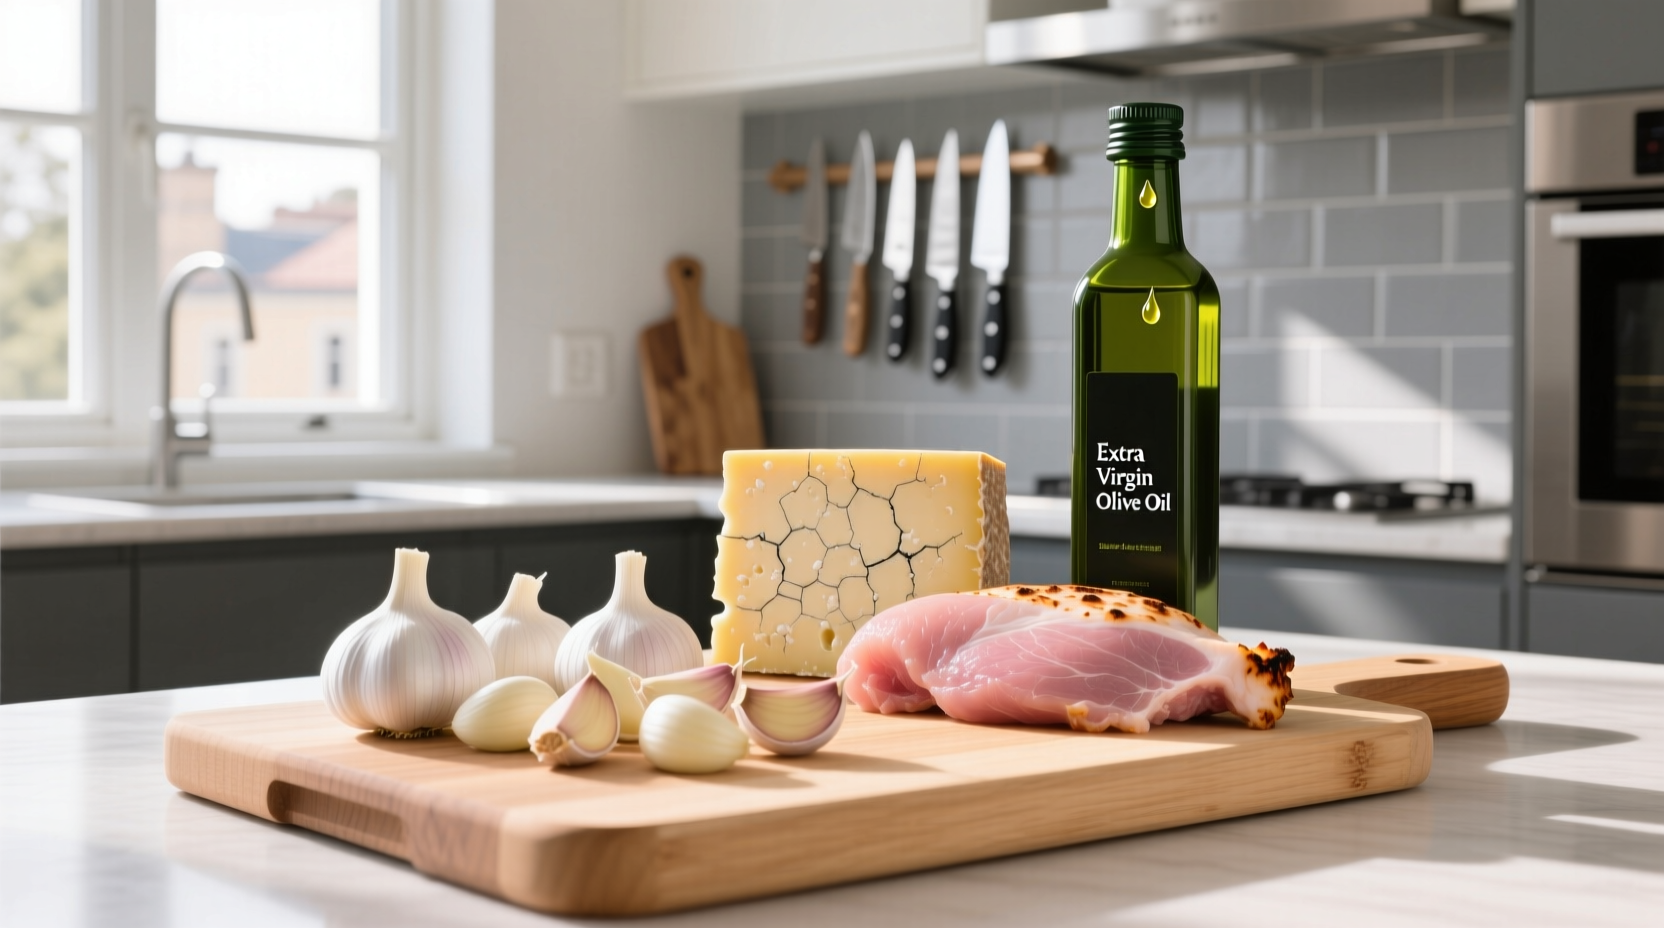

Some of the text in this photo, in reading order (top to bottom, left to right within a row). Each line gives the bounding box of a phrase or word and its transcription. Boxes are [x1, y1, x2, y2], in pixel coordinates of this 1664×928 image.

[1096, 441, 1145, 462] Extra
[1096, 467, 1153, 491] Virgin
[1096, 491, 1171, 511] Olive Oil
